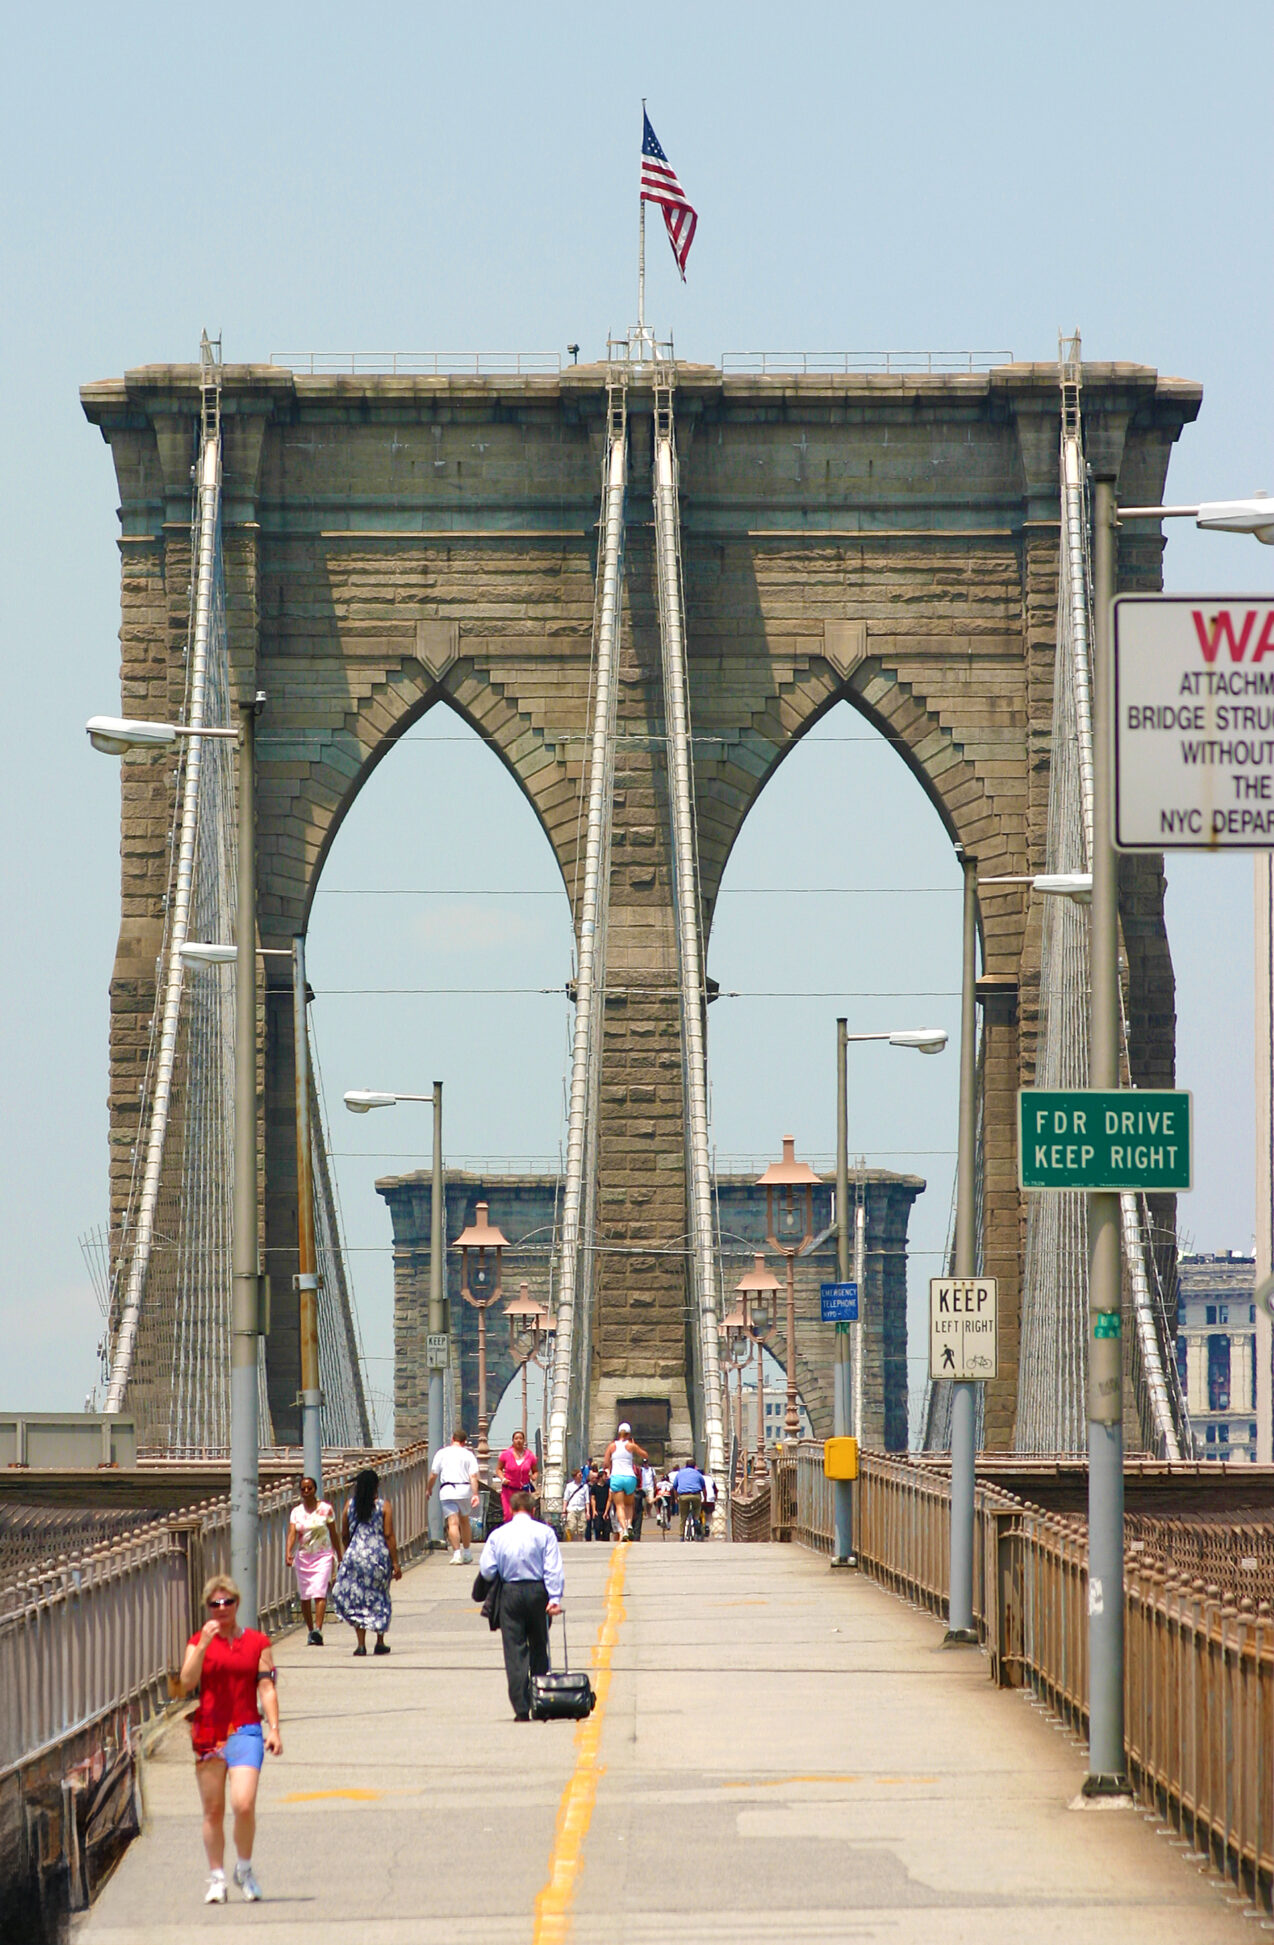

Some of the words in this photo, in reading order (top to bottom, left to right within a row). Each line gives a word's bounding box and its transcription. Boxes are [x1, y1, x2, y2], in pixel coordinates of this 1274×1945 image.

[1128, 706, 1205, 730] BRIDGE
[1216, 706, 1274, 731] STRU
[1181, 740, 1274, 765] WITHOUT
[1232, 775, 1272, 799] THE
[1161, 809, 1202, 834] NYC
[1036, 1111, 1087, 1134] FDR
[1105, 1111, 1175, 1135] DRIVE
[1035, 1145, 1095, 1169] KEEP
[1111, 1146, 1178, 1169] RIGHT
[823, 1299, 857, 1308] TELEPHONE
[939, 1289, 988, 1312] KEEP
[935, 1320, 959, 1333] LEFT
[965, 1320, 994, 1333] RIGHT
[429, 1336, 446, 1346] KEEP
